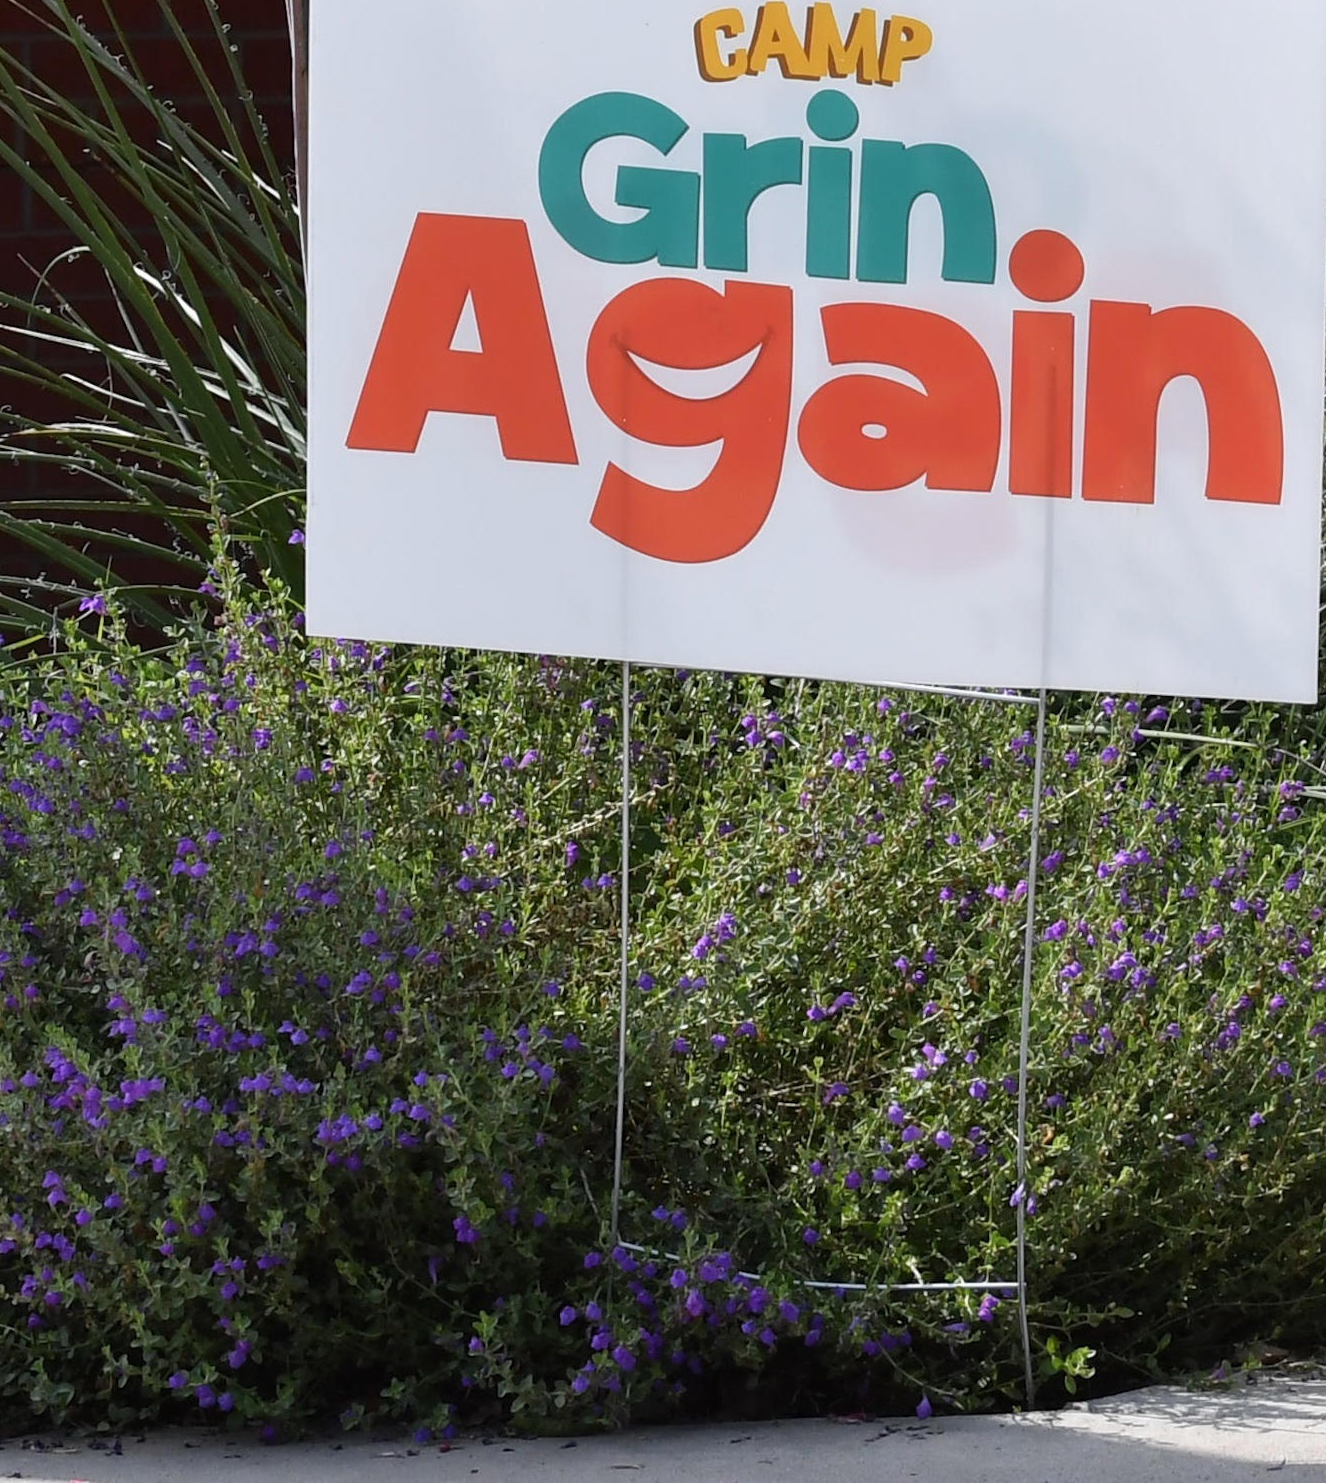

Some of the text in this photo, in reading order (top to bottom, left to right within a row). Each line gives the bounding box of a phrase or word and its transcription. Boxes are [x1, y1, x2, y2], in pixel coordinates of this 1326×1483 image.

[693, 0, 933, 87] CAMP
[538, 89, 996, 284] Grin
[345, 211, 1284, 563] Again
